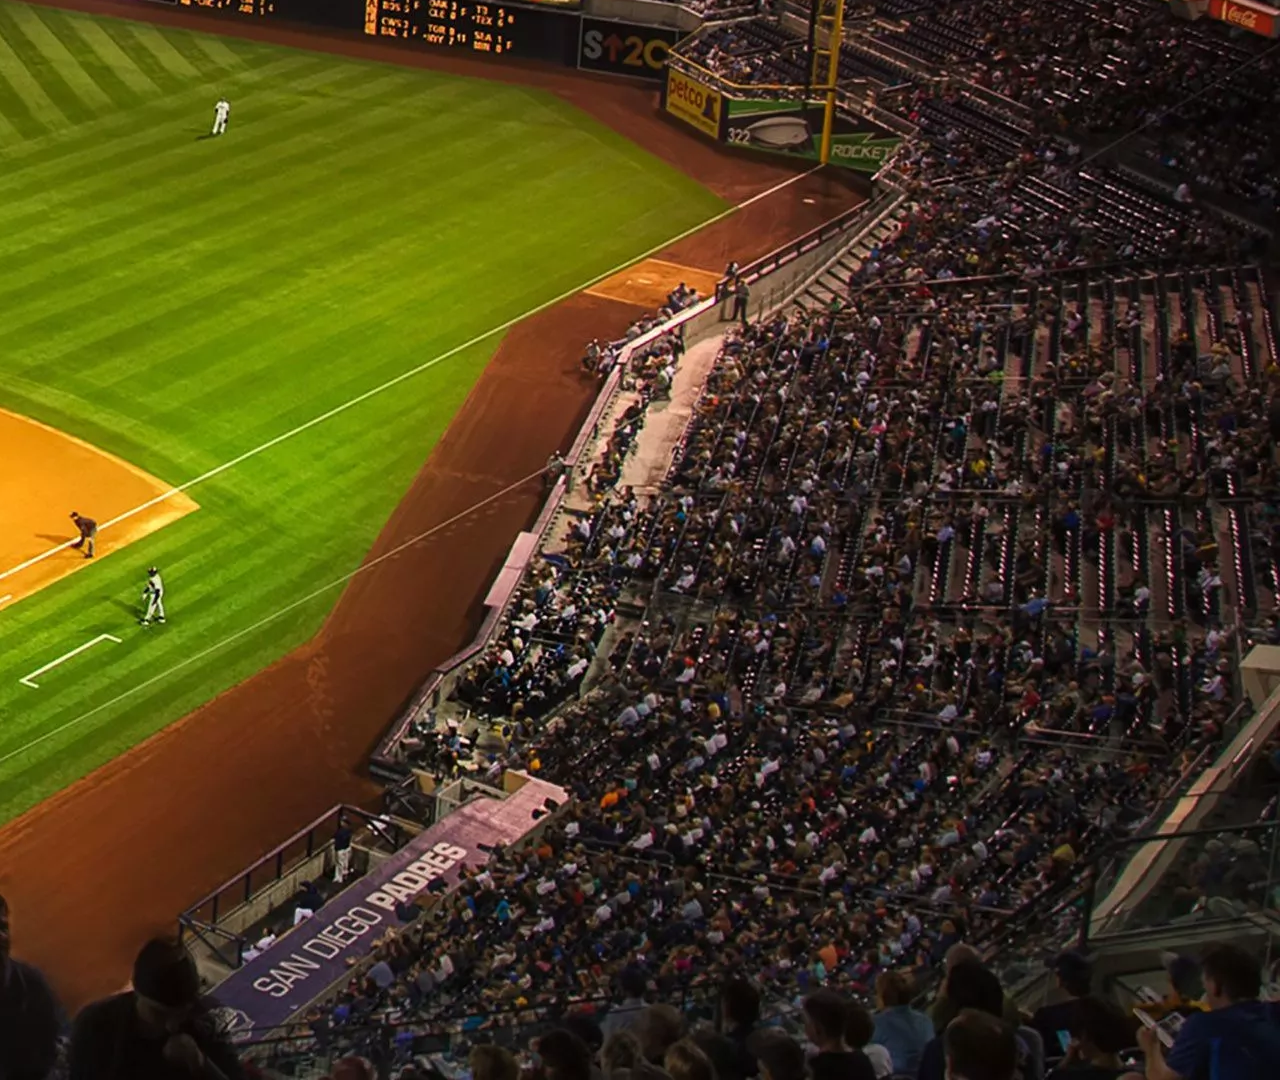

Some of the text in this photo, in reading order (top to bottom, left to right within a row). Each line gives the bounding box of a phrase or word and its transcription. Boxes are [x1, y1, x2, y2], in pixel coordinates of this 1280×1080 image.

[670, 78, 703, 109] petco
[728, 128, 750, 145] 322
[253, 842, 467, 998] SAN DIEGO PADRES
